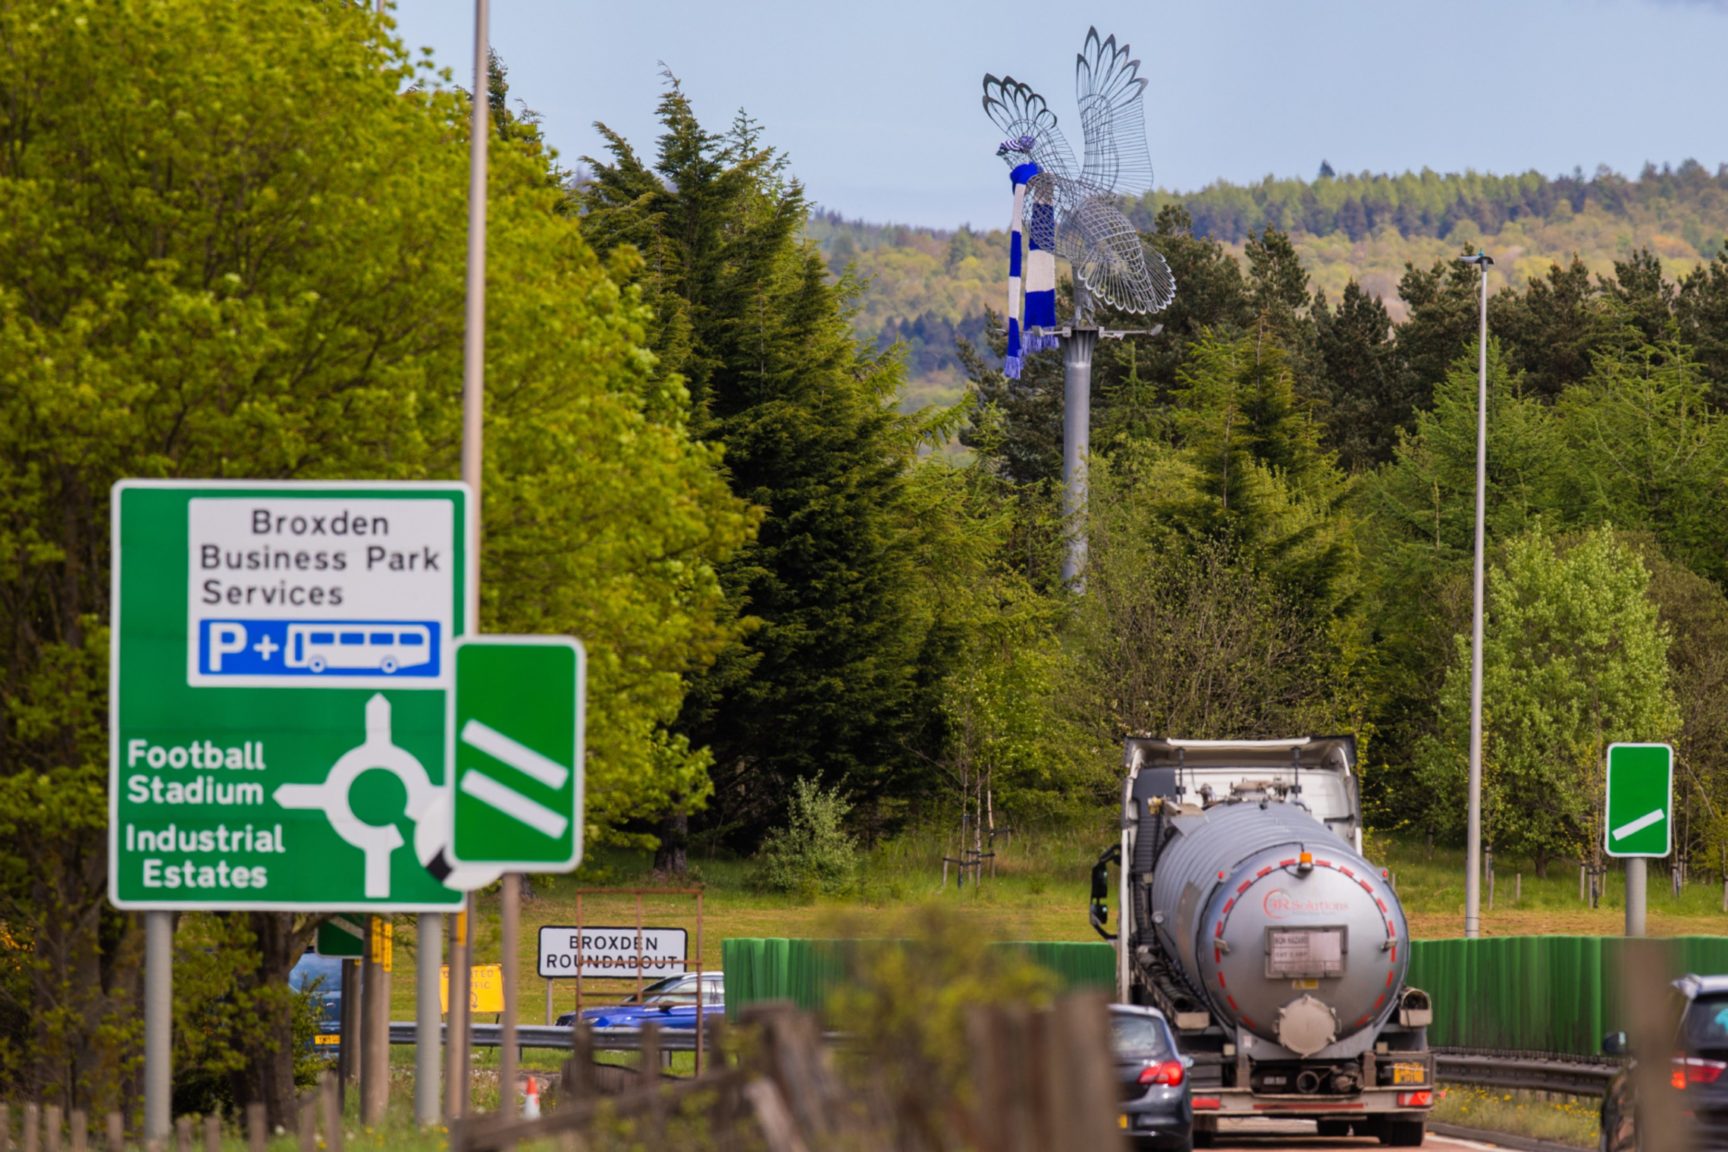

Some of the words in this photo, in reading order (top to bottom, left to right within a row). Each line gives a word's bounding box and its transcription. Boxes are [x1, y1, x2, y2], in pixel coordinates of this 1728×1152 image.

[252, 510, 389, 535] Broxden
[200, 545, 347, 570] Business
[366, 546, 440, 571] Park
[202, 580, 344, 605] Services
[128, 739, 266, 770] Football
[127, 775, 264, 805] Stadium
[126, 823, 286, 853] Industrial
[143, 859, 268, 888] Estates
[569, 935, 658, 950] BROXDEN
[546, 954, 678, 969] ROUNDABOUT
